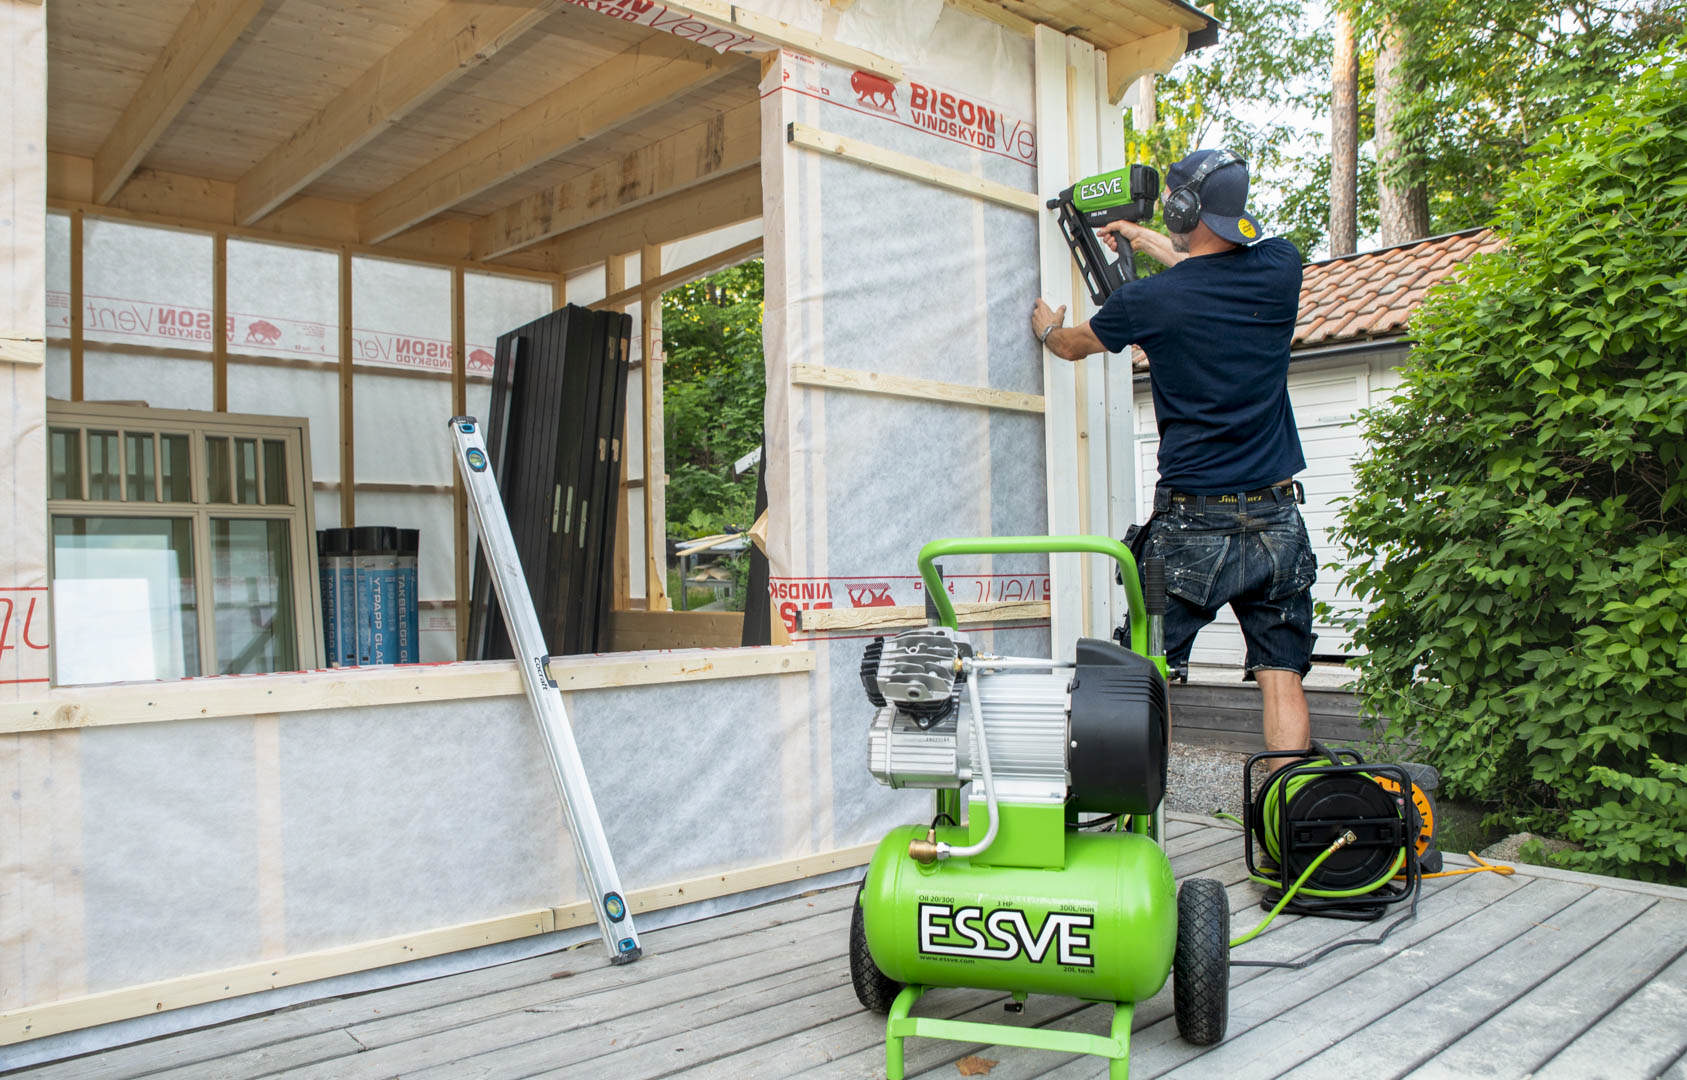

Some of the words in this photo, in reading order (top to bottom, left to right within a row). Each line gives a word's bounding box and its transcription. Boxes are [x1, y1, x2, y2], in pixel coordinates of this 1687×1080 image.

[649, 5, 755, 52] Vent
[910, 82, 996, 134] BISON
[910, 109, 996, 149] VINDSKYDD
[1081, 176, 1122, 200] ESSVE
[918, 894, 929, 902] Oil
[930, 896, 955, 904] 20/300
[918, 902, 1095, 967] ESSVE
[919, 955, 975, 965] www.essve.com
[1077, 967, 1095, 975] tank
